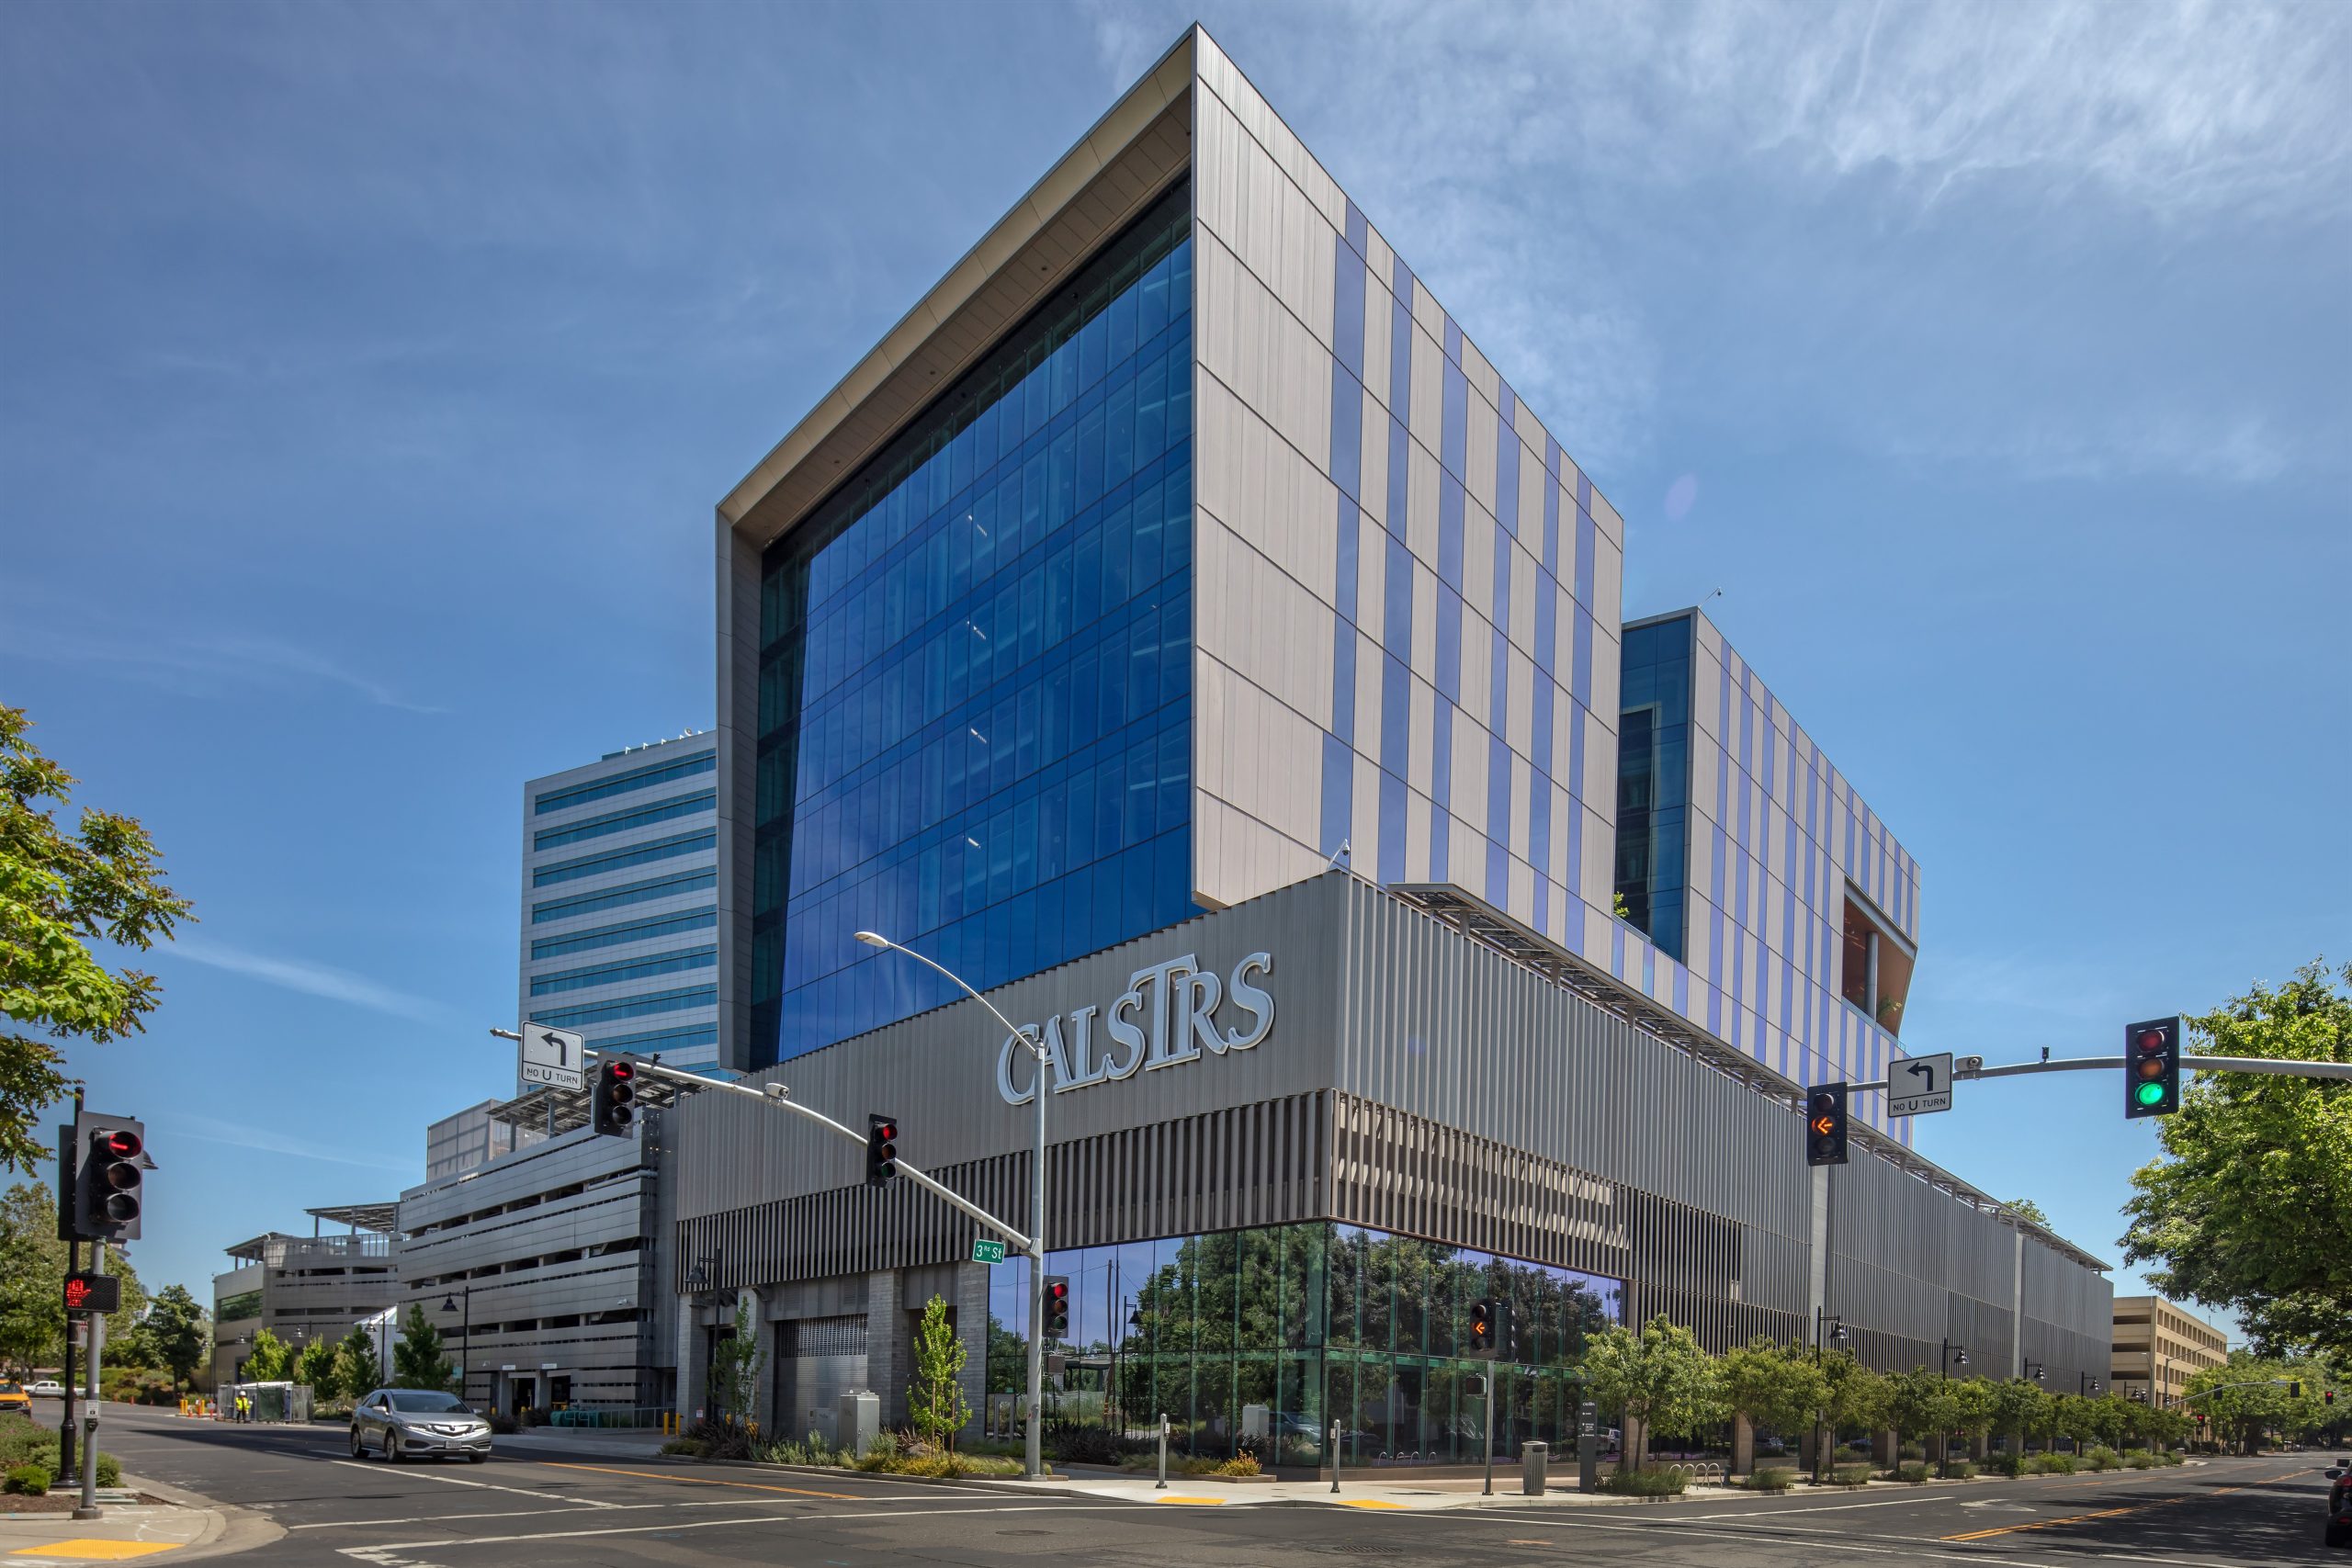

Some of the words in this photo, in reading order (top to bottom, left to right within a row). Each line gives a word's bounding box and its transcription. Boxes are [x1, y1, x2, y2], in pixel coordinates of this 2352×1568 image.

[997, 952, 1275, 1106] CALSTRS
[526, 1067, 539, 1077] NO
[542, 1069, 552, 1081] U
[556, 1073, 578, 1085] TURN
[1893, 1102, 1905, 1111] NO
[1908, 1100, 1918, 1111] U
[1922, 1097, 1946, 1108] TURN
[991, 1247, 1002, 1259] St
